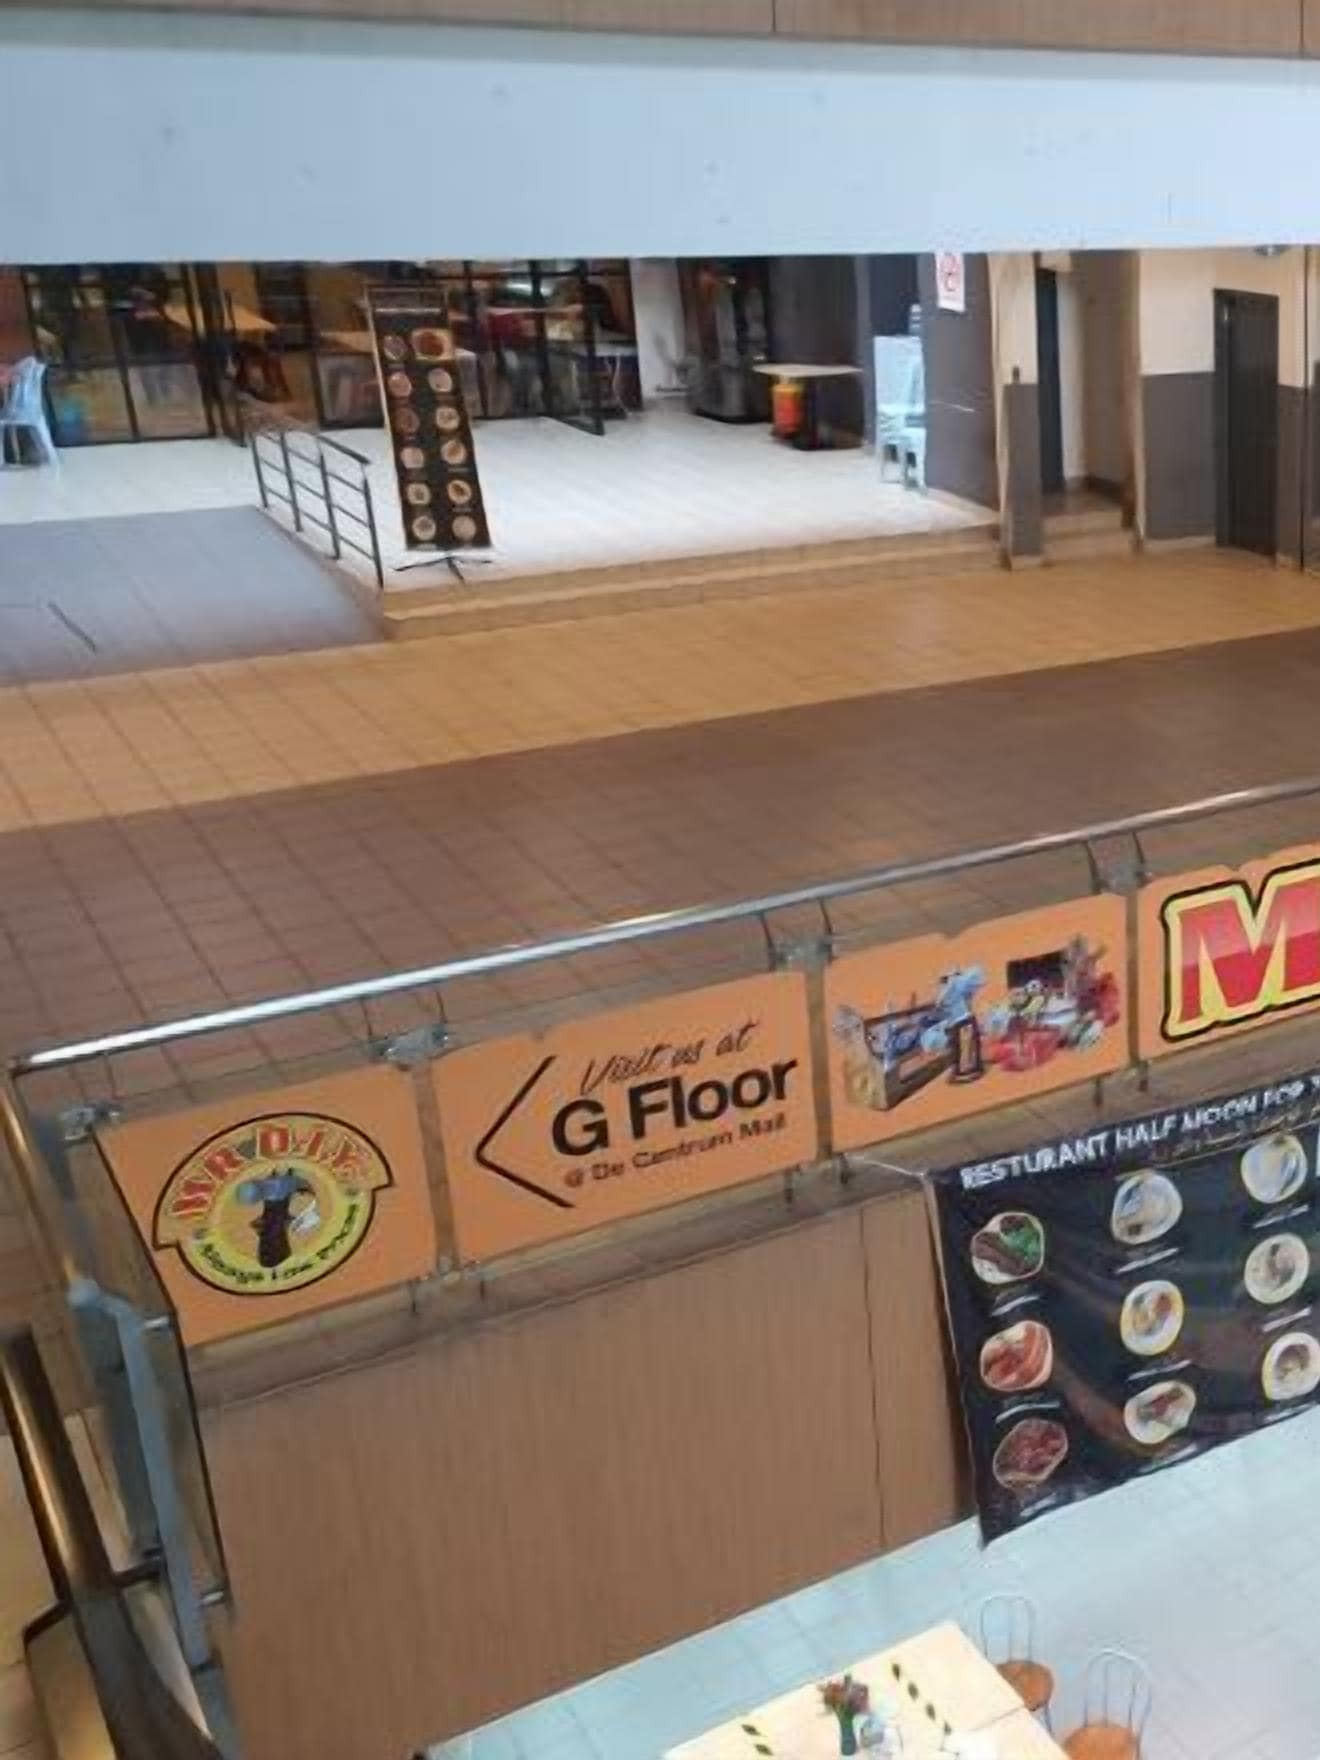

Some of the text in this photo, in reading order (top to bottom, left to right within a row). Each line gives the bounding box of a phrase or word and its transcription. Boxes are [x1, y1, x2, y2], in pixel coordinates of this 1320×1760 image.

[580, 1018, 760, 1096] Visit us at
[552, 1058, 798, 1156] G Floor
[1115, 1114, 1177, 1150] HALF
[1181, 1096, 1257, 1133] MOON
[592, 1161, 625, 1181] De
[632, 1131, 733, 1170] Centrum
[739, 1112, 786, 1140] Mall
